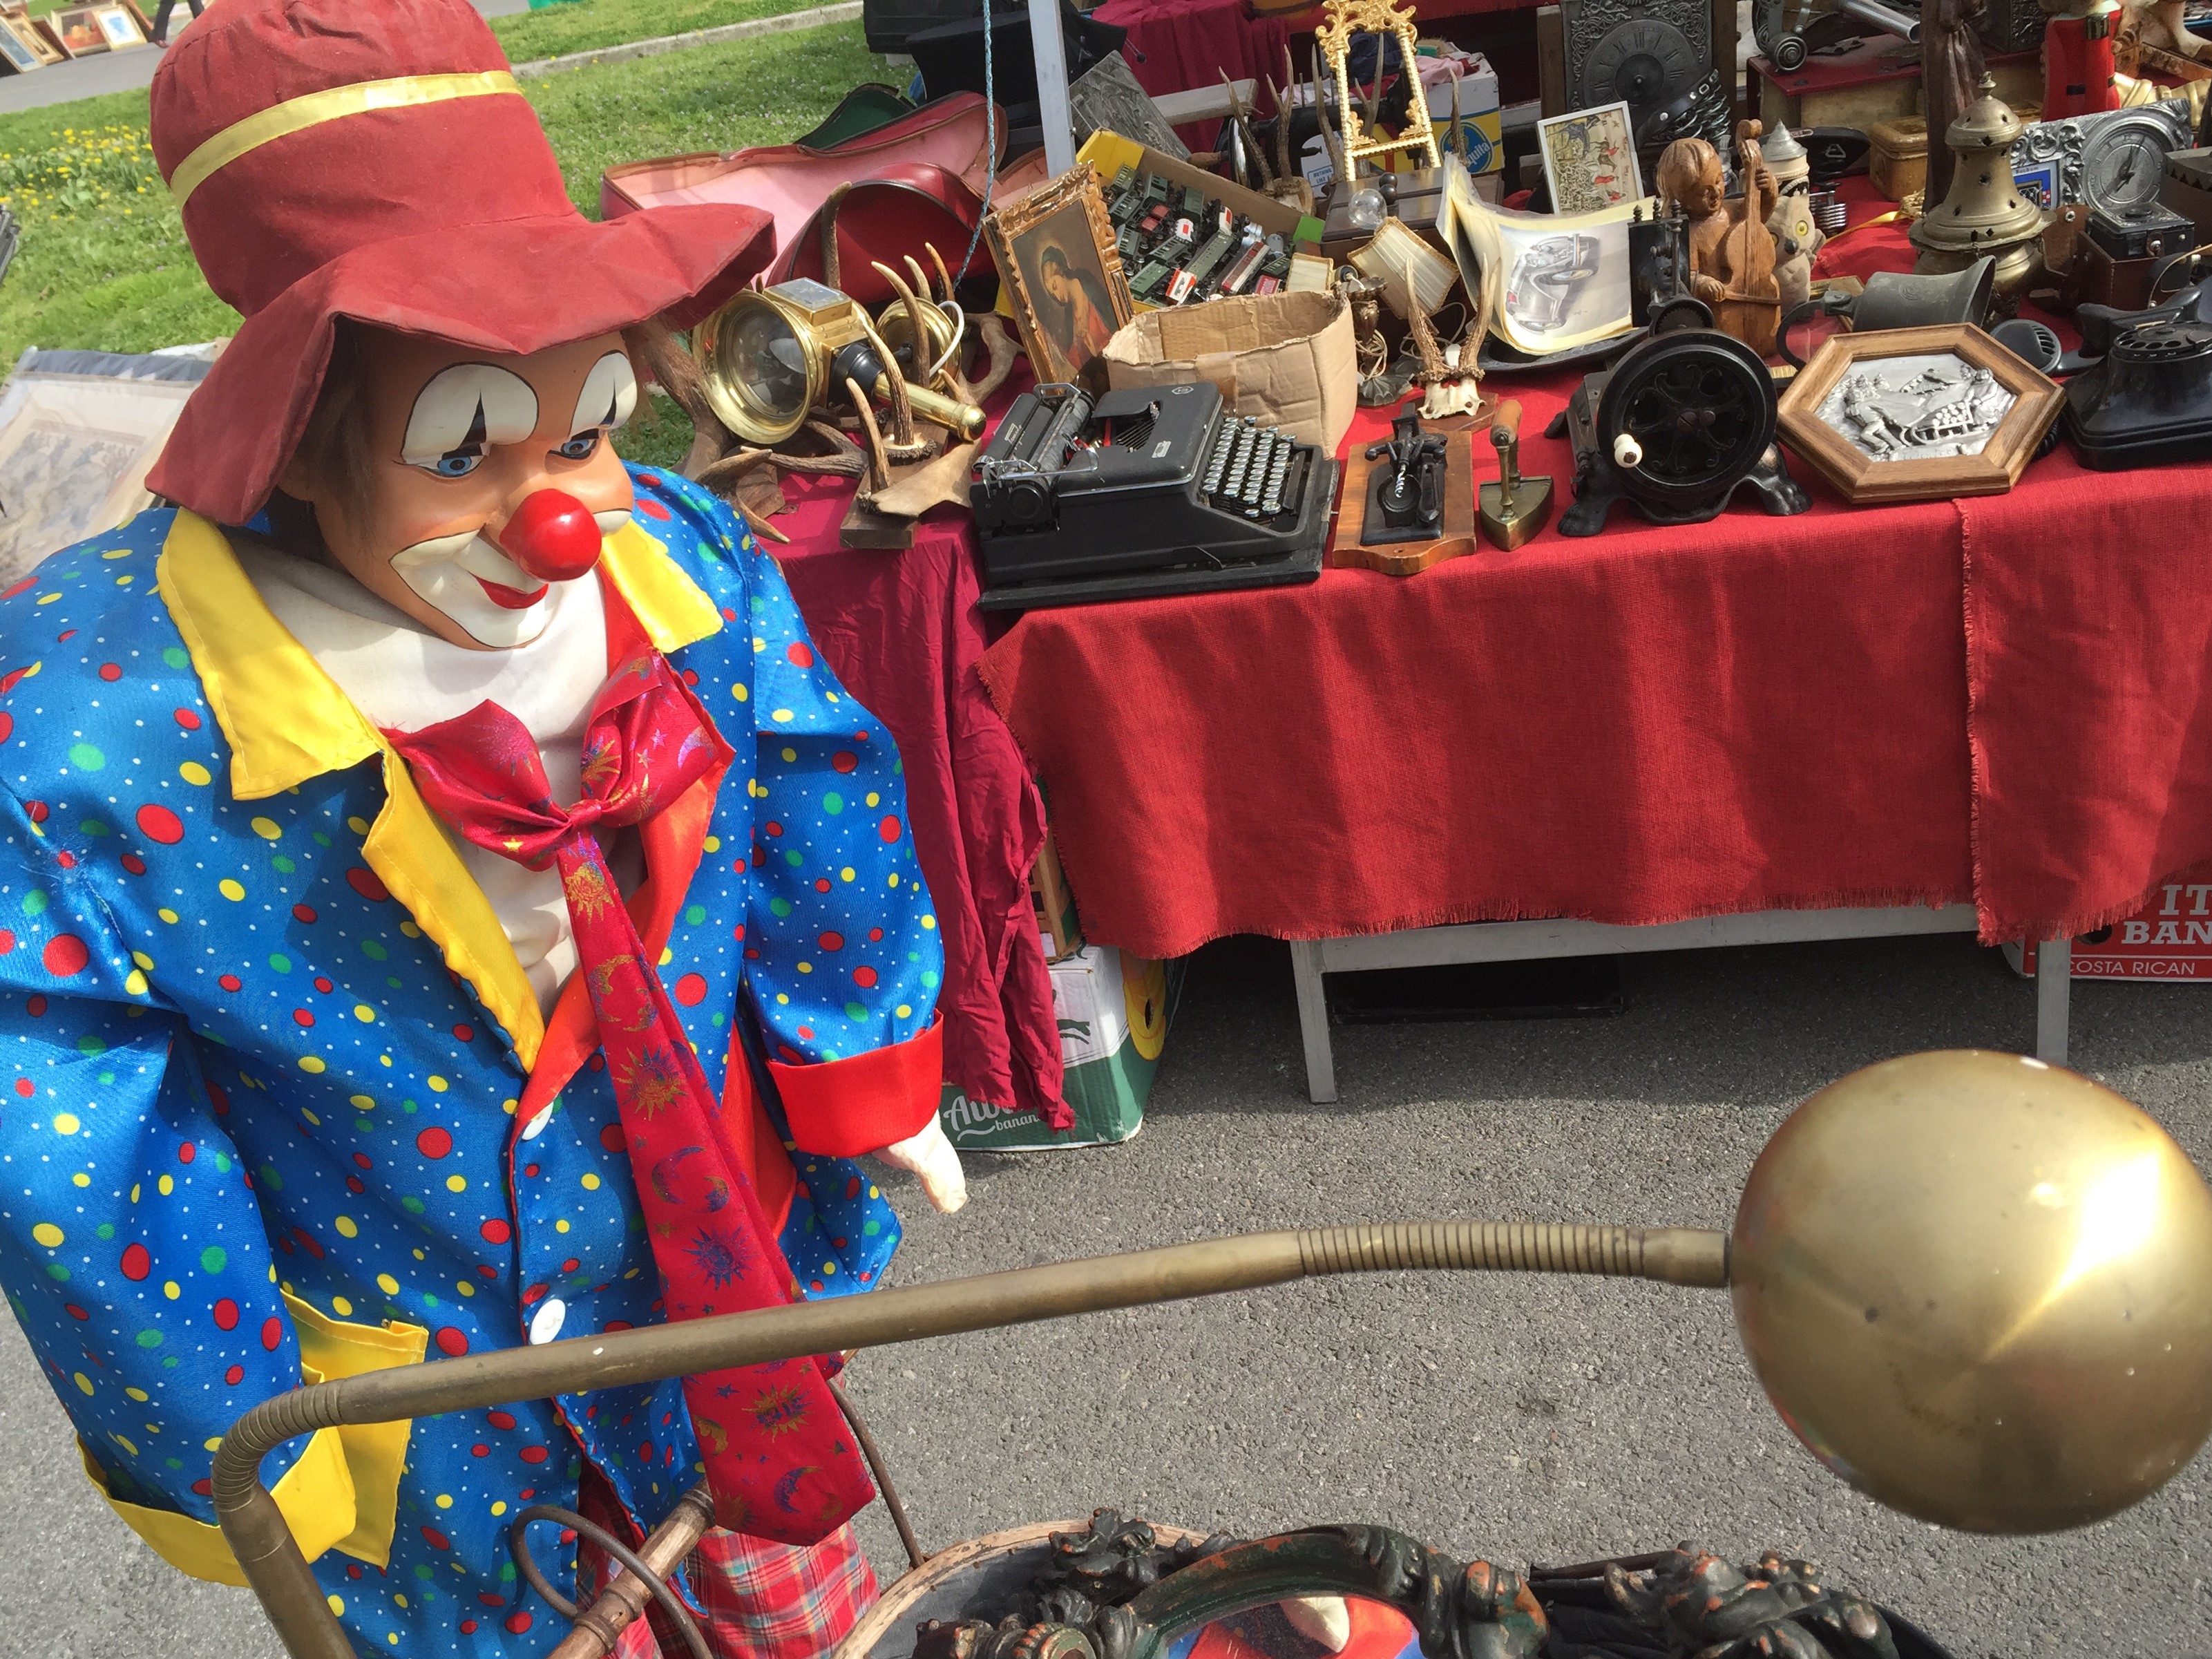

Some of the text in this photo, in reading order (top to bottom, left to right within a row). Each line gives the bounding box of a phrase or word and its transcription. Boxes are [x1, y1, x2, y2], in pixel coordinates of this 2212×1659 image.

[1466, 142, 1491, 165] quita
[2132, 962, 2195, 975] RICAN
[995, 1114, 1041, 1131] banan
